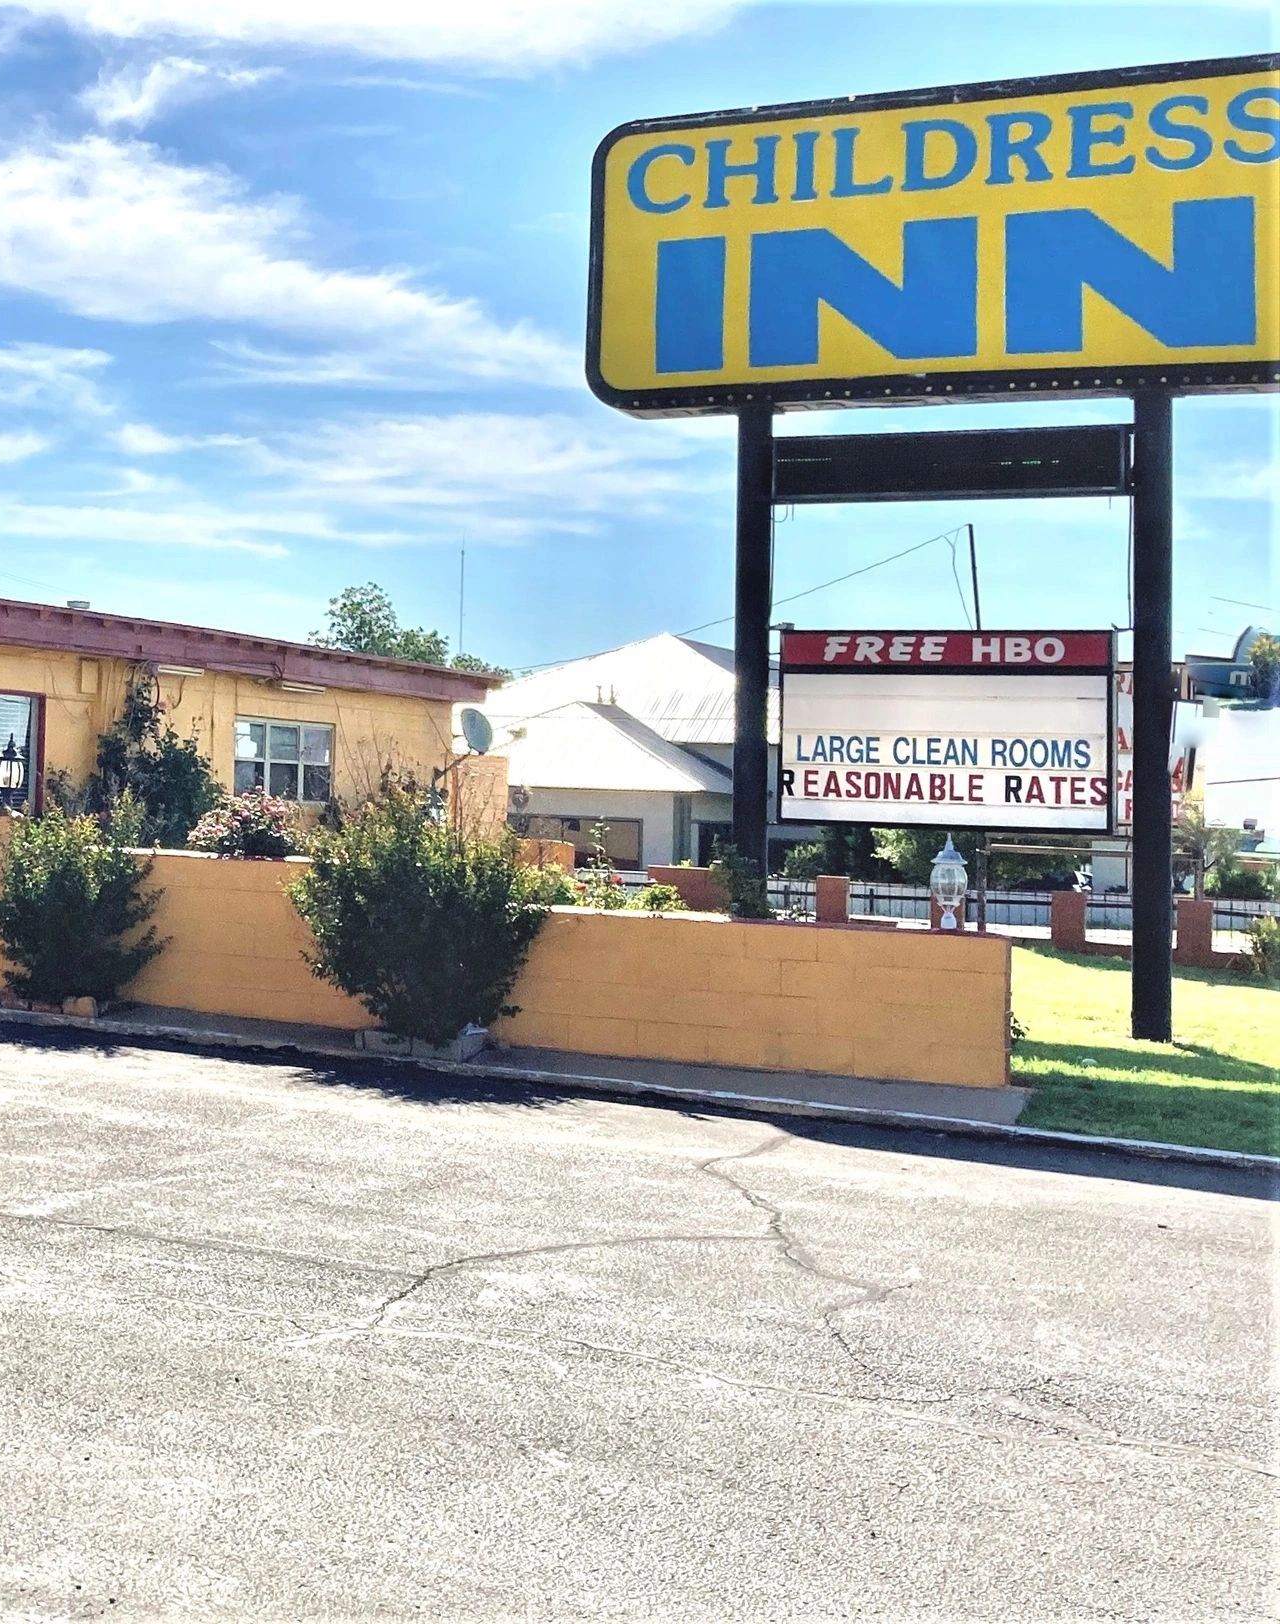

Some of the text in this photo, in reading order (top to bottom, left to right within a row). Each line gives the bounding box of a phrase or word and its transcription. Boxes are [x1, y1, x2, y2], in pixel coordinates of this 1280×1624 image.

[627, 87, 1280, 214] CHILDRESS
[655, 196, 1256, 373] INN
[823, 636, 1066, 663] FREE HBO
[796, 735, 880, 764] LARGE
[893, 737, 978, 765] CLEAN
[991, 738, 1091, 769] ROOMS
[781, 769, 984, 802] REASONABLE
[1005, 775, 1108, 806] RATES
